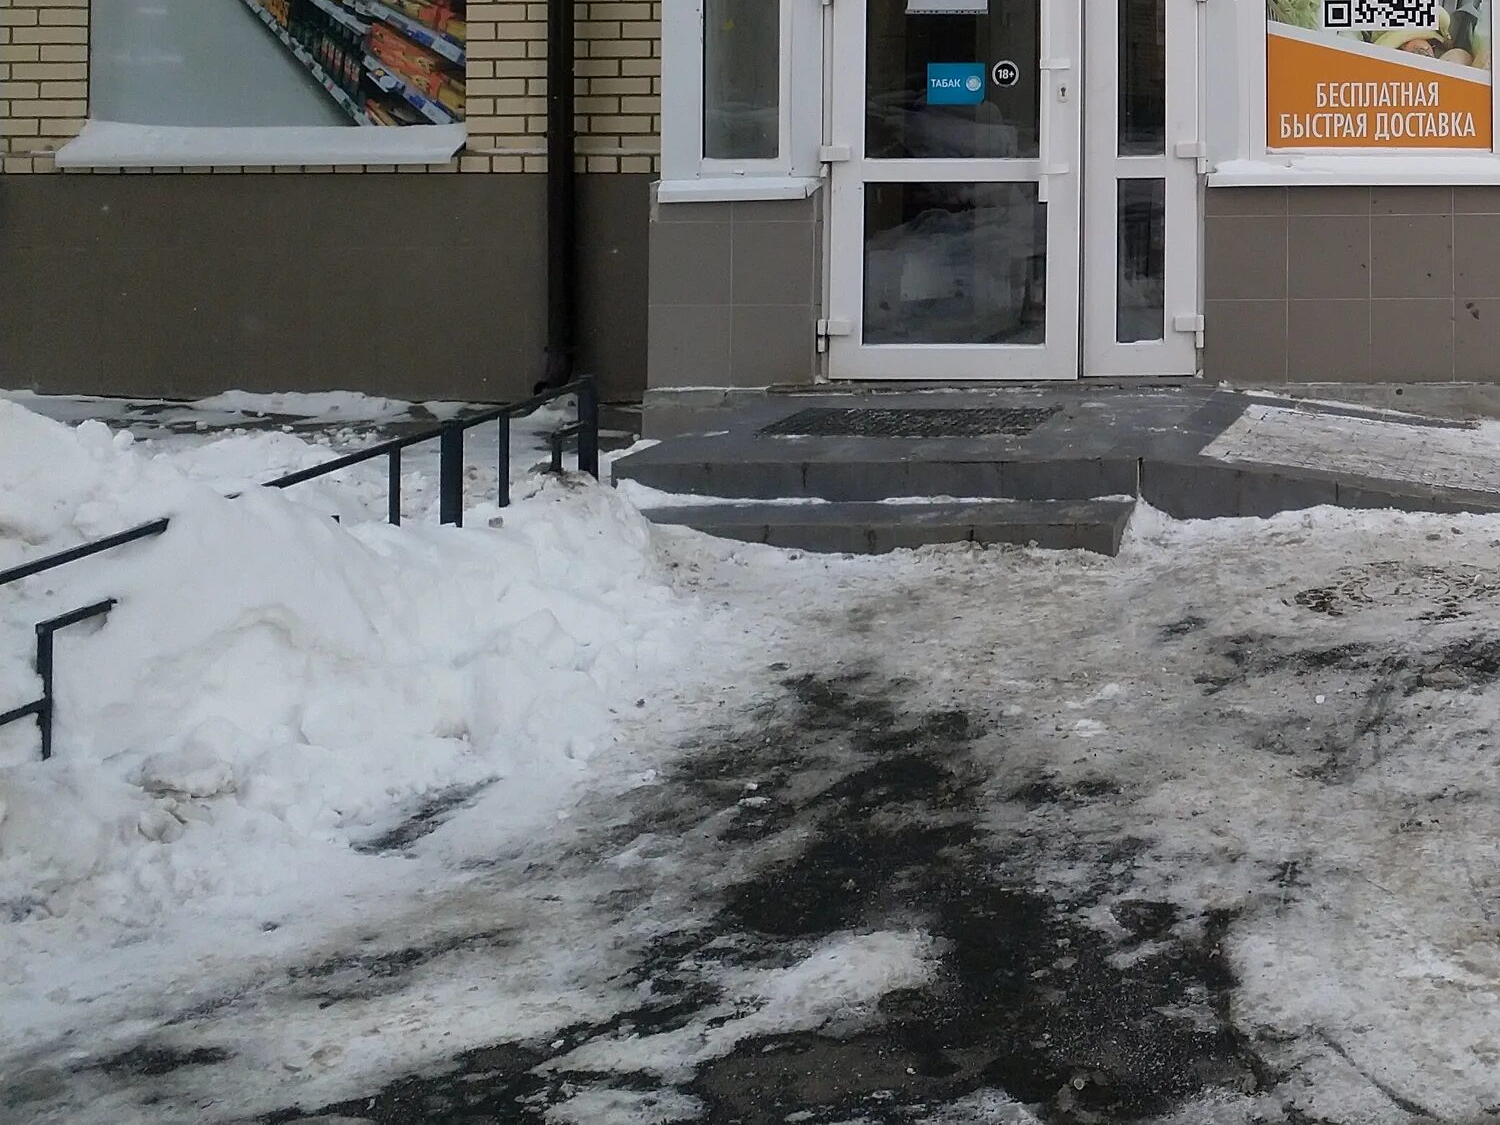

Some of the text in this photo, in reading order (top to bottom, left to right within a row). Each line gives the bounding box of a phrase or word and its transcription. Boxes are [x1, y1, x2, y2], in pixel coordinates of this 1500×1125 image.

[931, 78, 961, 88] ТАБАК
[997, 68, 1015, 80] 18+
[1316, 82, 1439, 108] БЕСПЛАТНАЯ
[1280, 113, 1477, 141] БЫСТРАЯ ДОСТАВКА
